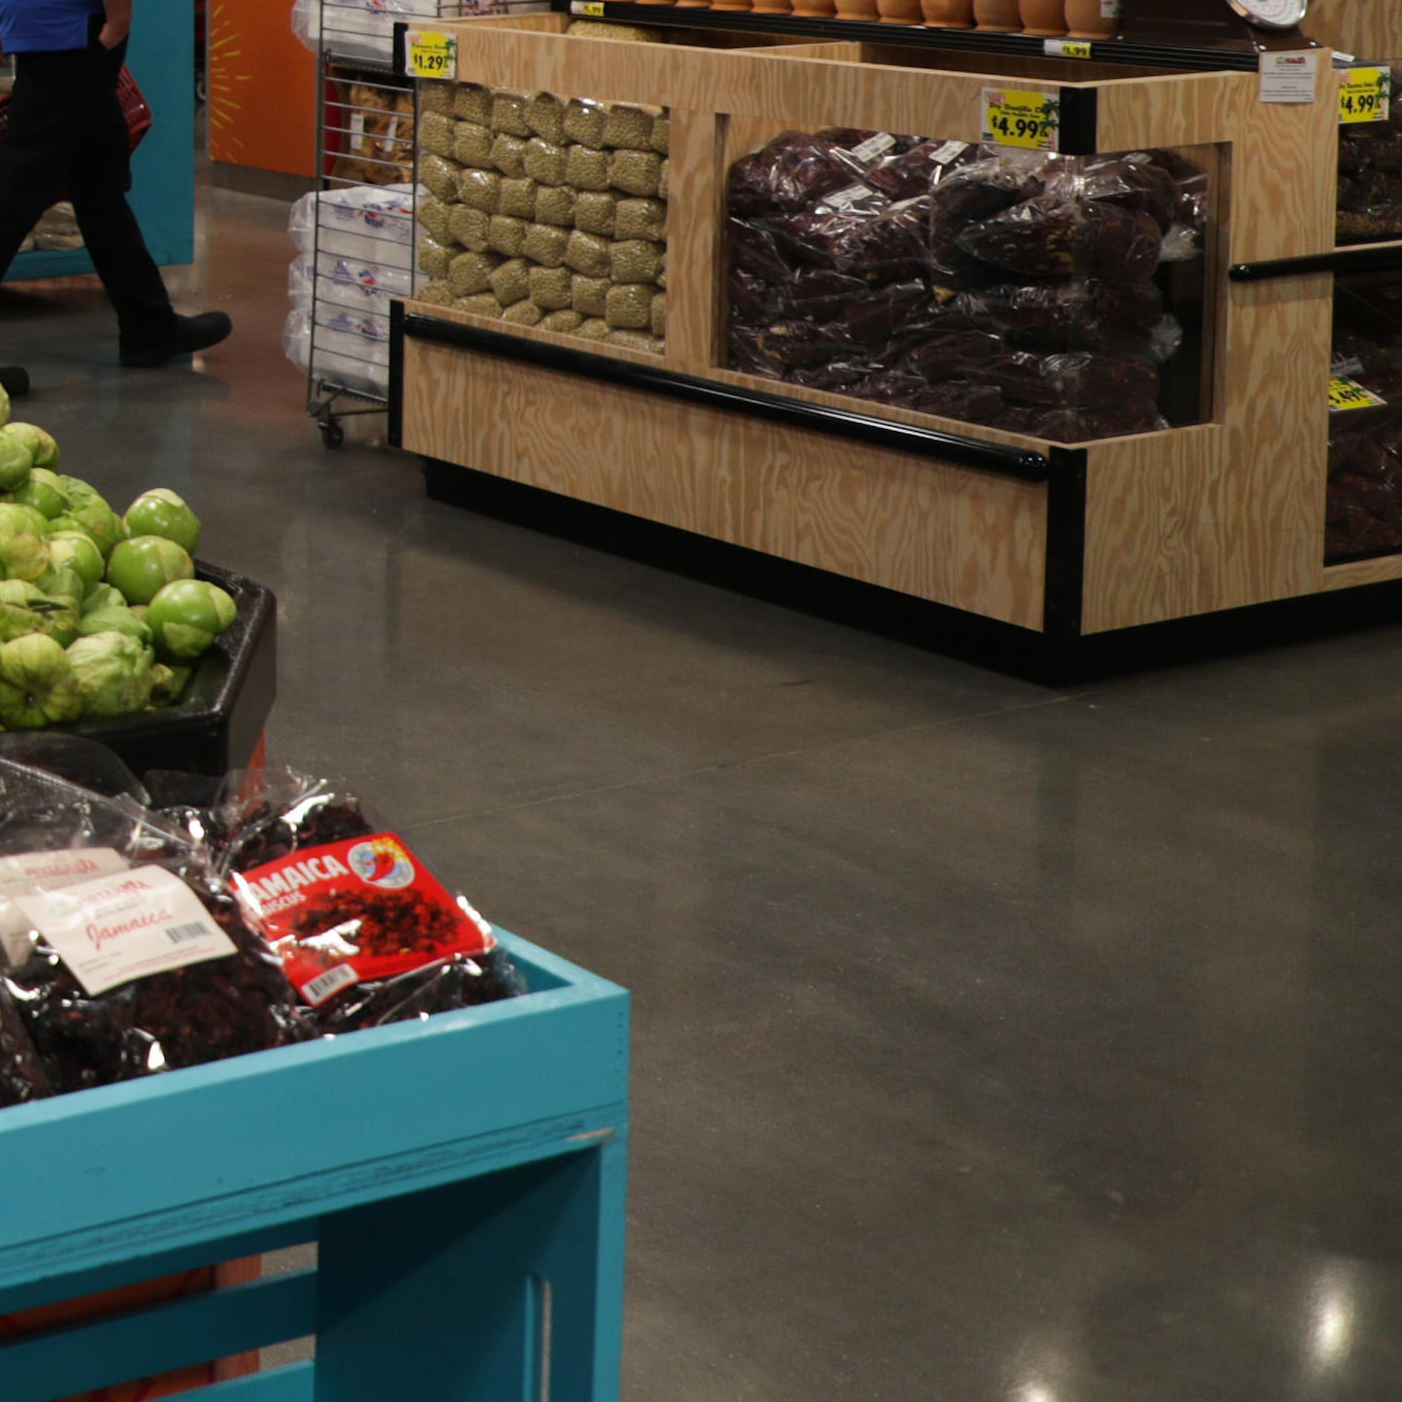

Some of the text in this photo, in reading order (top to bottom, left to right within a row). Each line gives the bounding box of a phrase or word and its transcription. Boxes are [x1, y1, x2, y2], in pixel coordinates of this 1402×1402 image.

[1341, 94, 1374, 115] $4.99
[992, 115, 1038, 139] $4.99
[235, 854, 350, 904] AMAICA
[85, 907, 172, 951] Jamaica
